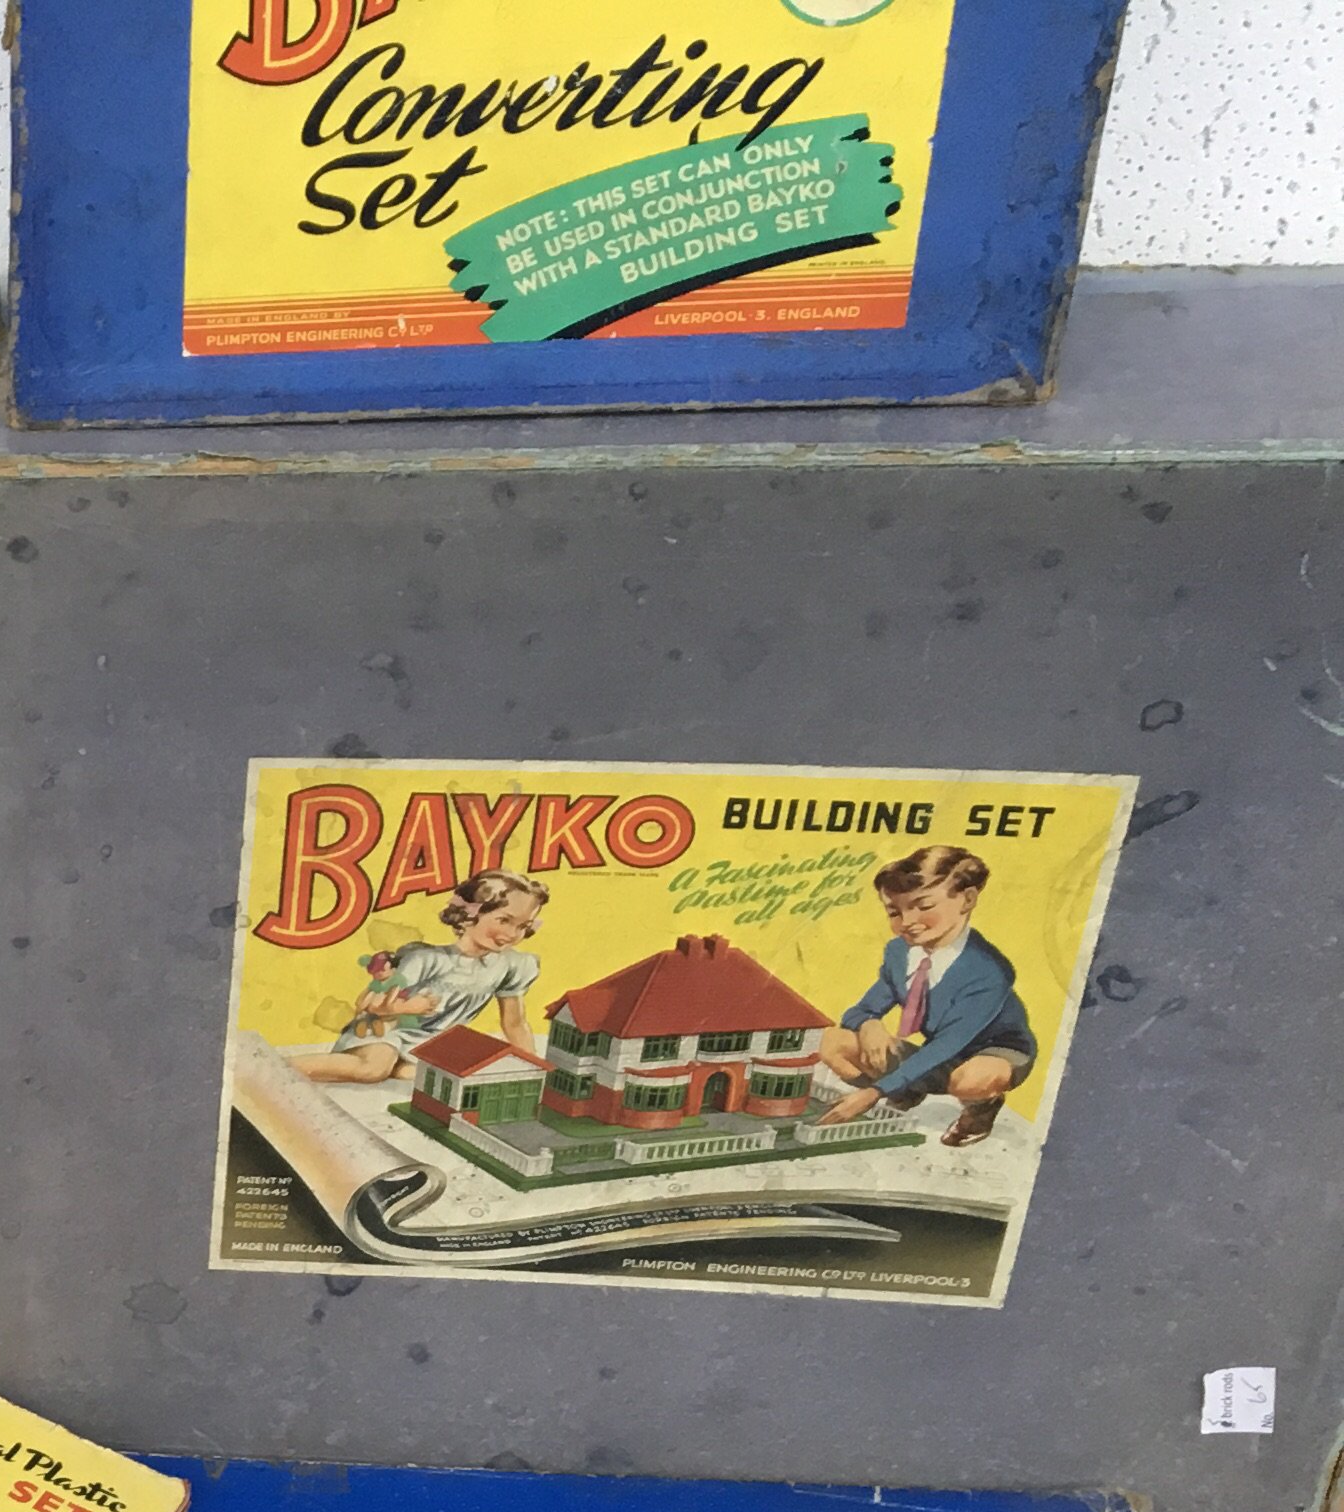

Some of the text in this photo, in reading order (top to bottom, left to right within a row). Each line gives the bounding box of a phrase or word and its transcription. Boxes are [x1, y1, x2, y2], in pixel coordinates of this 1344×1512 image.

[299, 35, 824, 151] Converting
[297, 148, 488, 235] Set
[506, 158, 820, 275] BE USED IN CONJUNCTION
[573, 187, 626, 218] THIS
[631, 170, 671, 198] SET
[678, 152, 731, 182] CAN
[743, 135, 814, 166] ONLY
[514, 179, 835, 297] WITH A STANDARD BAYKO
[620, 205, 829, 283] BUILDING SET
[206, 327, 384, 346] PLIMPTON ENGINEERING
[777, 306, 861, 321] ENGLAND
[252, 784, 1056, 951] BAYKO BUILDING SET
[622, 1258, 817, 1279] PLIMPTON ENGINEERING
[1221, 1372, 1233, 1418] brick rods
